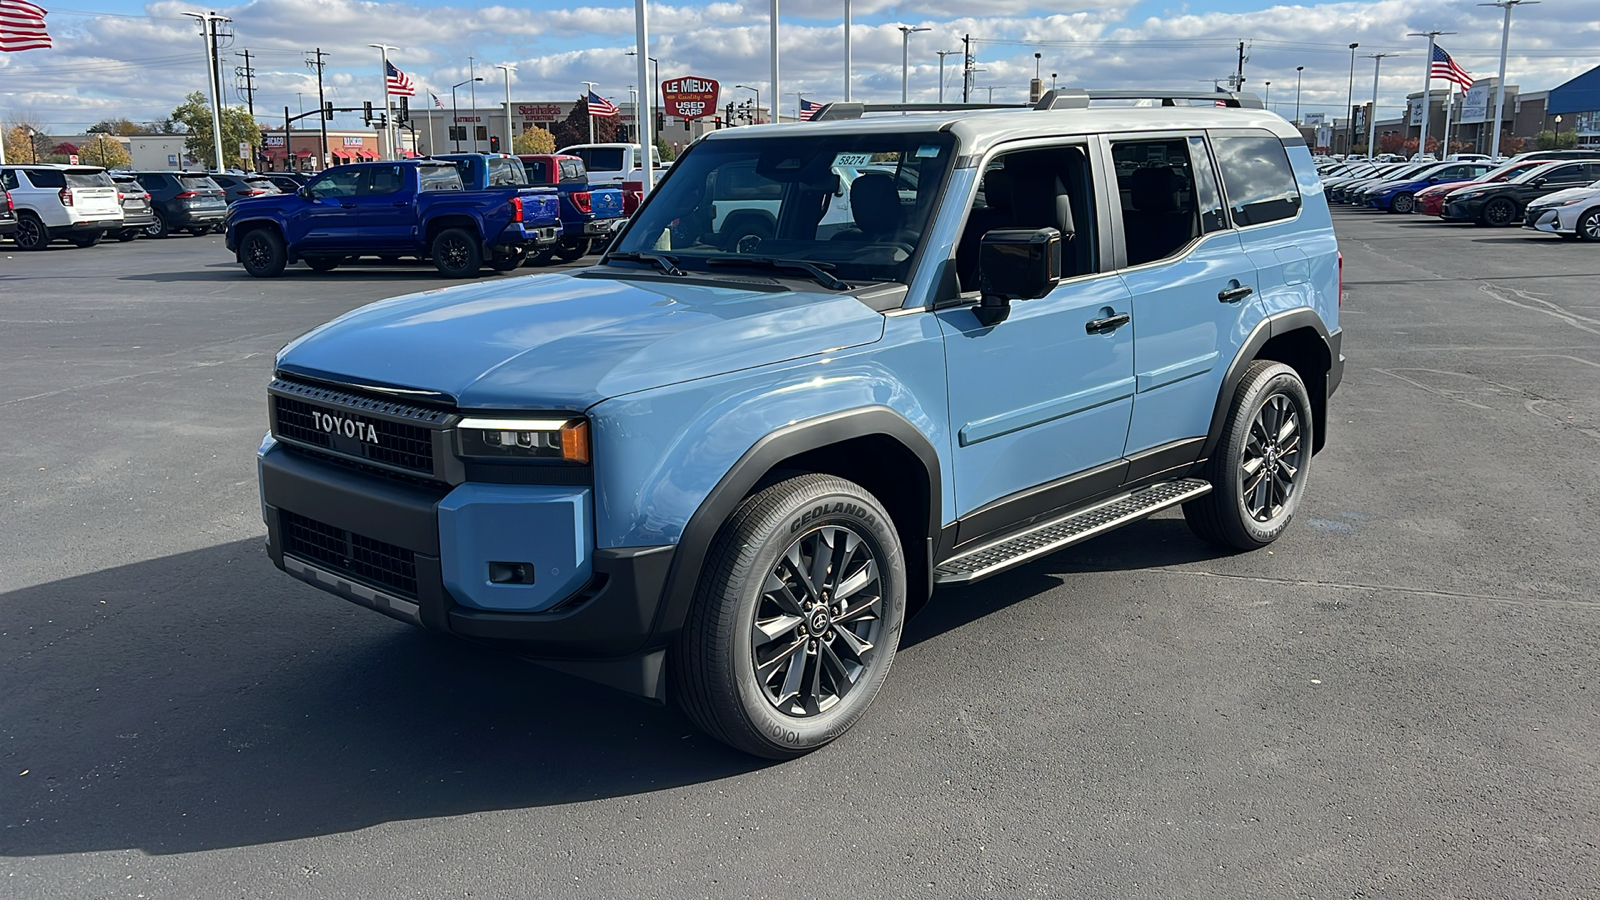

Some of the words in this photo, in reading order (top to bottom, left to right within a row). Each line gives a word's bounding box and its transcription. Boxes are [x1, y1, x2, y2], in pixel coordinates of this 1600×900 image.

[666, 81, 678, 93] LE
[681, 79, 713, 93] MIEUX
[679, 108, 702, 116] CARS
[838, 155, 866, 165] 58274
[312, 411, 379, 444] TOYOTA
[791, 502, 885, 535] GEOLANDAR
